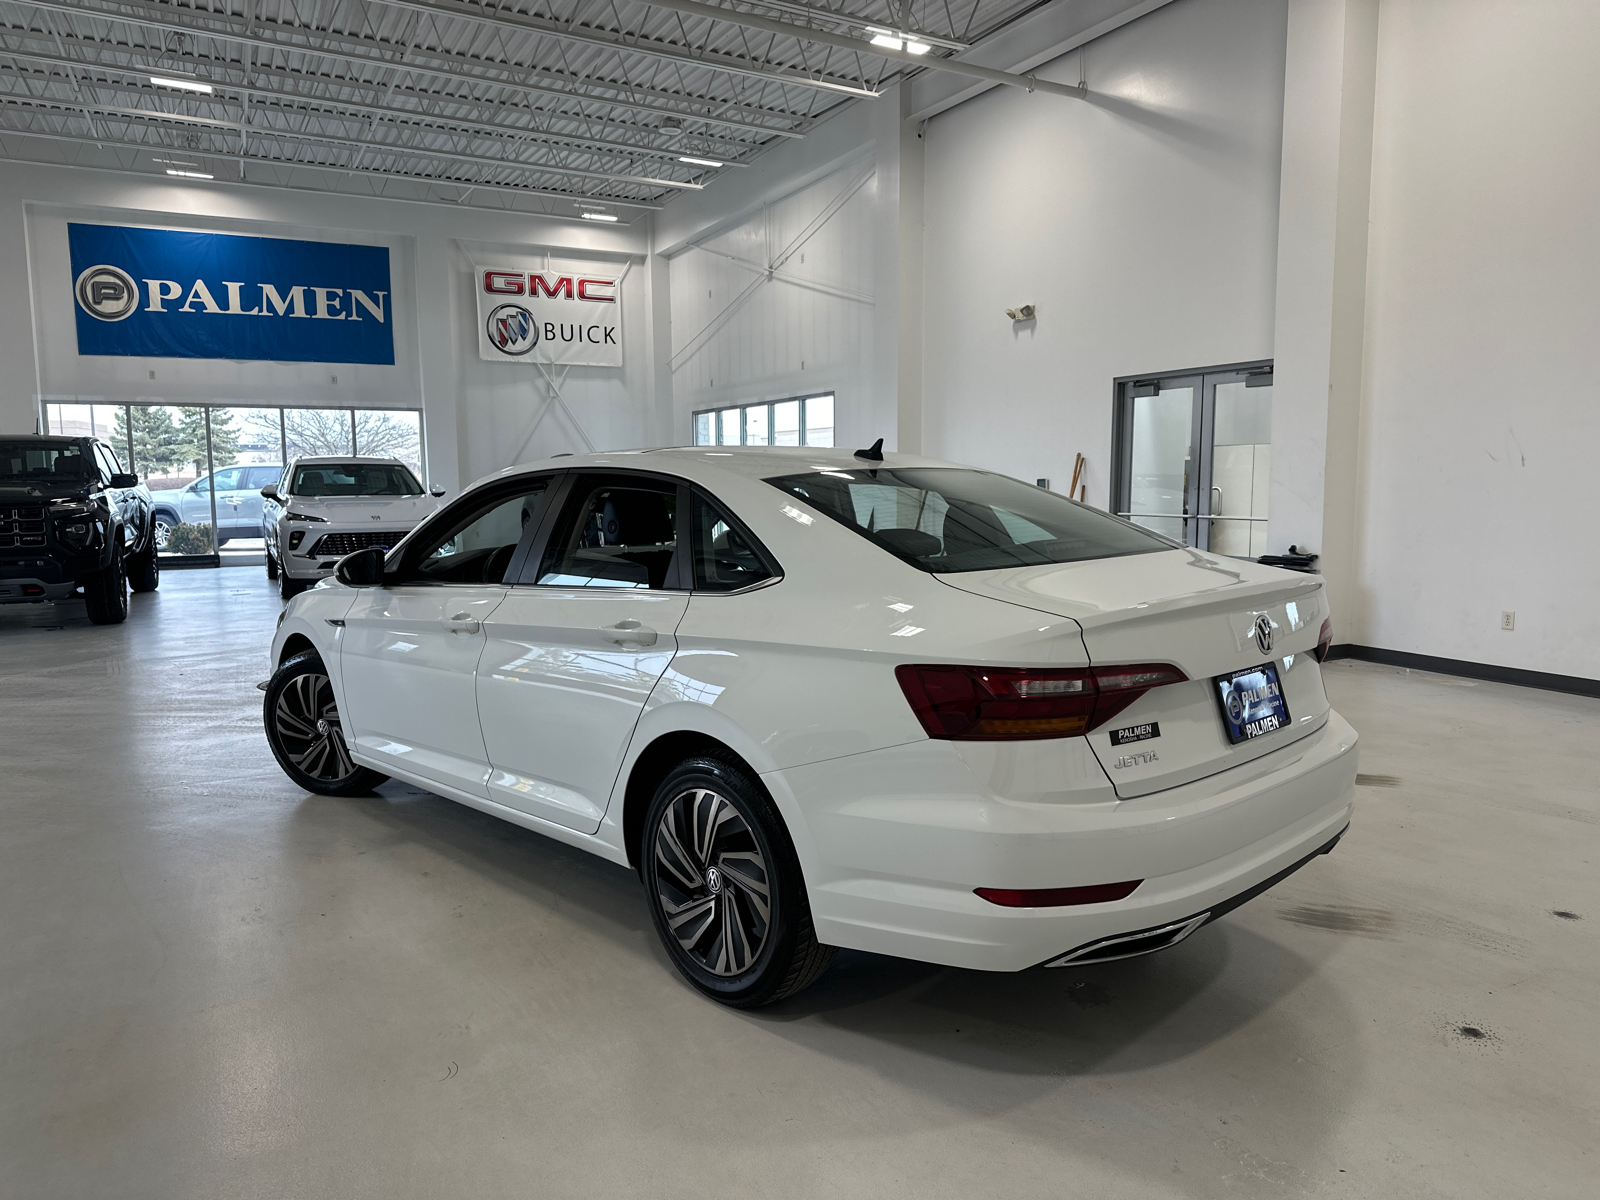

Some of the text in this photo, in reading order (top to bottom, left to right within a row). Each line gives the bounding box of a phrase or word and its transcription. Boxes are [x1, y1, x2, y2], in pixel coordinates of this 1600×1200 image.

[483, 269, 617, 304] GMC
[142, 278, 388, 324] PALMEN
[544, 322, 617, 345] BUICK
[1232, 666, 1264, 679] palmen.com
[1241, 682, 1280, 706] PALMEN
[1118, 724, 1152, 739] PALMEN
[1245, 714, 1280, 739] PALMEN
[1114, 750, 1160, 769] JETTA
